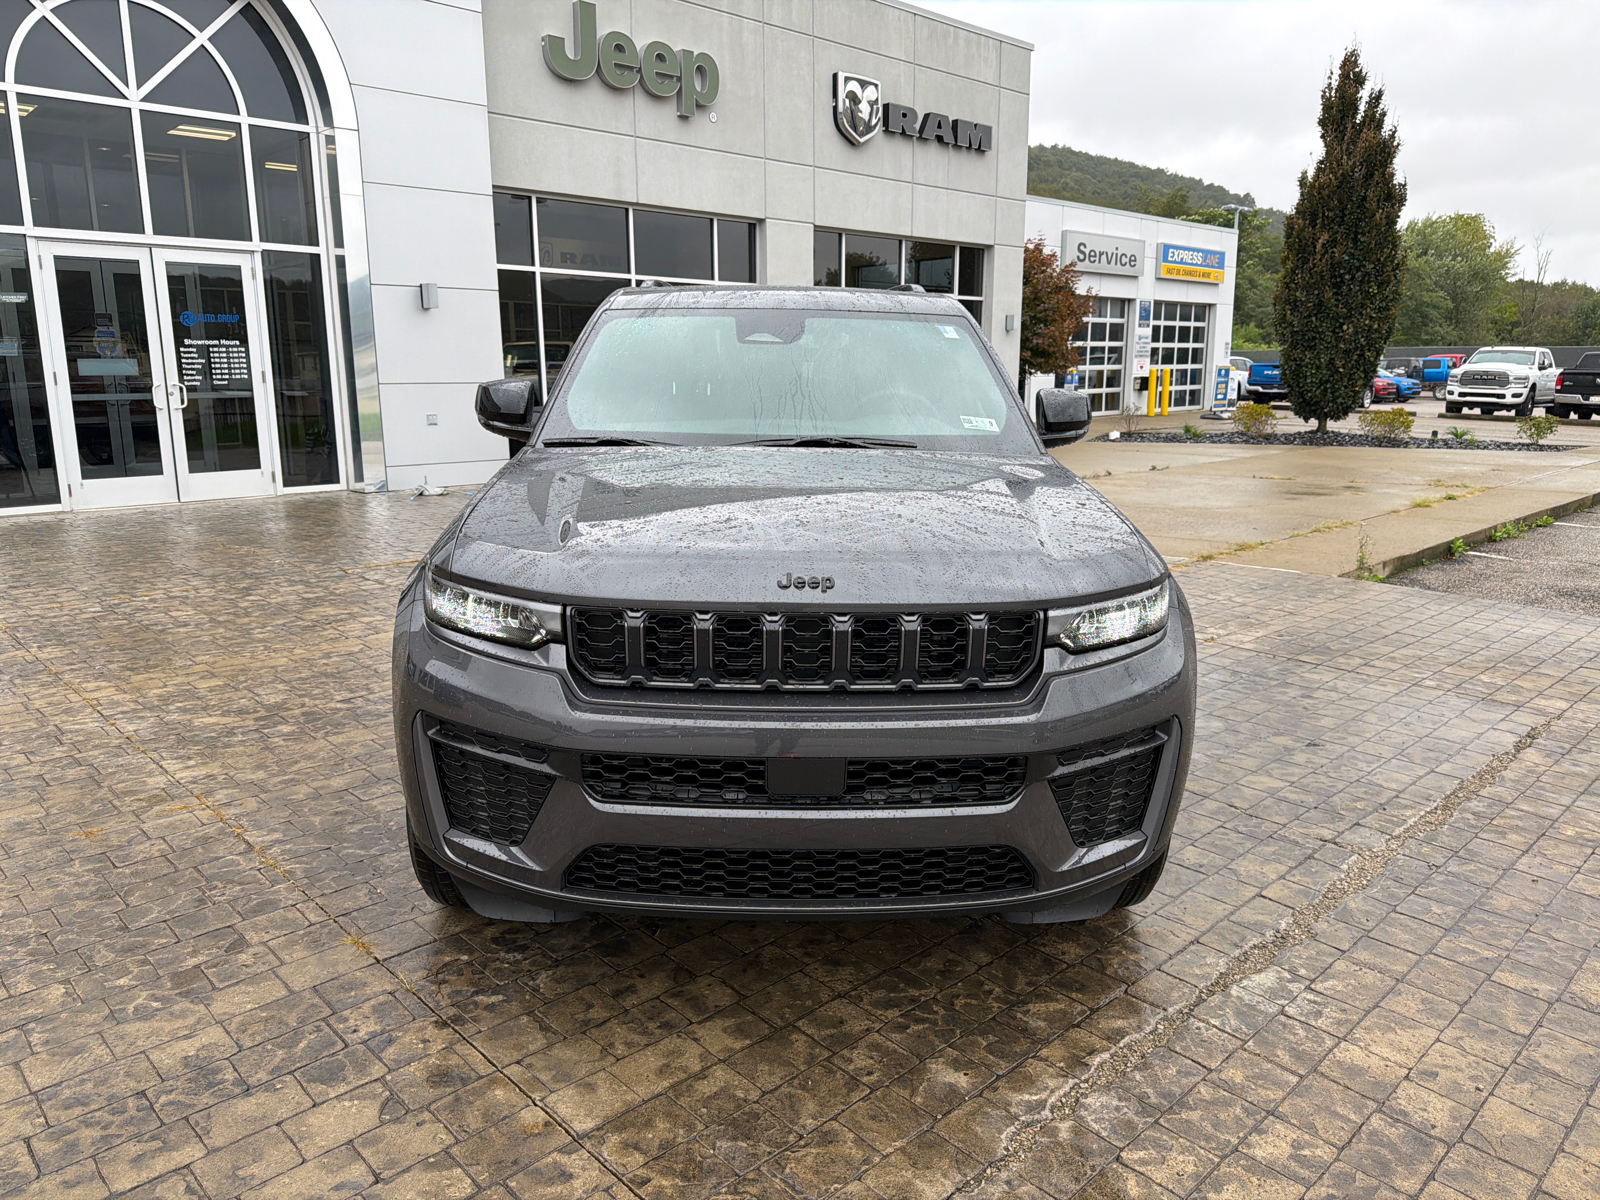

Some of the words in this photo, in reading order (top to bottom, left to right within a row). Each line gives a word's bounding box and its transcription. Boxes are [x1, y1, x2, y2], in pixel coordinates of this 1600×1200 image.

[541, 0, 720, 118] Jeep
[882, 102, 993, 151] RAM
[560, 252, 621, 268] RAM
[1076, 242, 1137, 268] Service
[1166, 268, 1175, 276] FAST
[1182, 269, 1198, 278] CHANGES
[1202, 271, 1212, 279] MORE
[198, 314, 215, 322] AUTO
[218, 314, 240, 323] GROUP
[777, 572, 835, 594] Jeep
